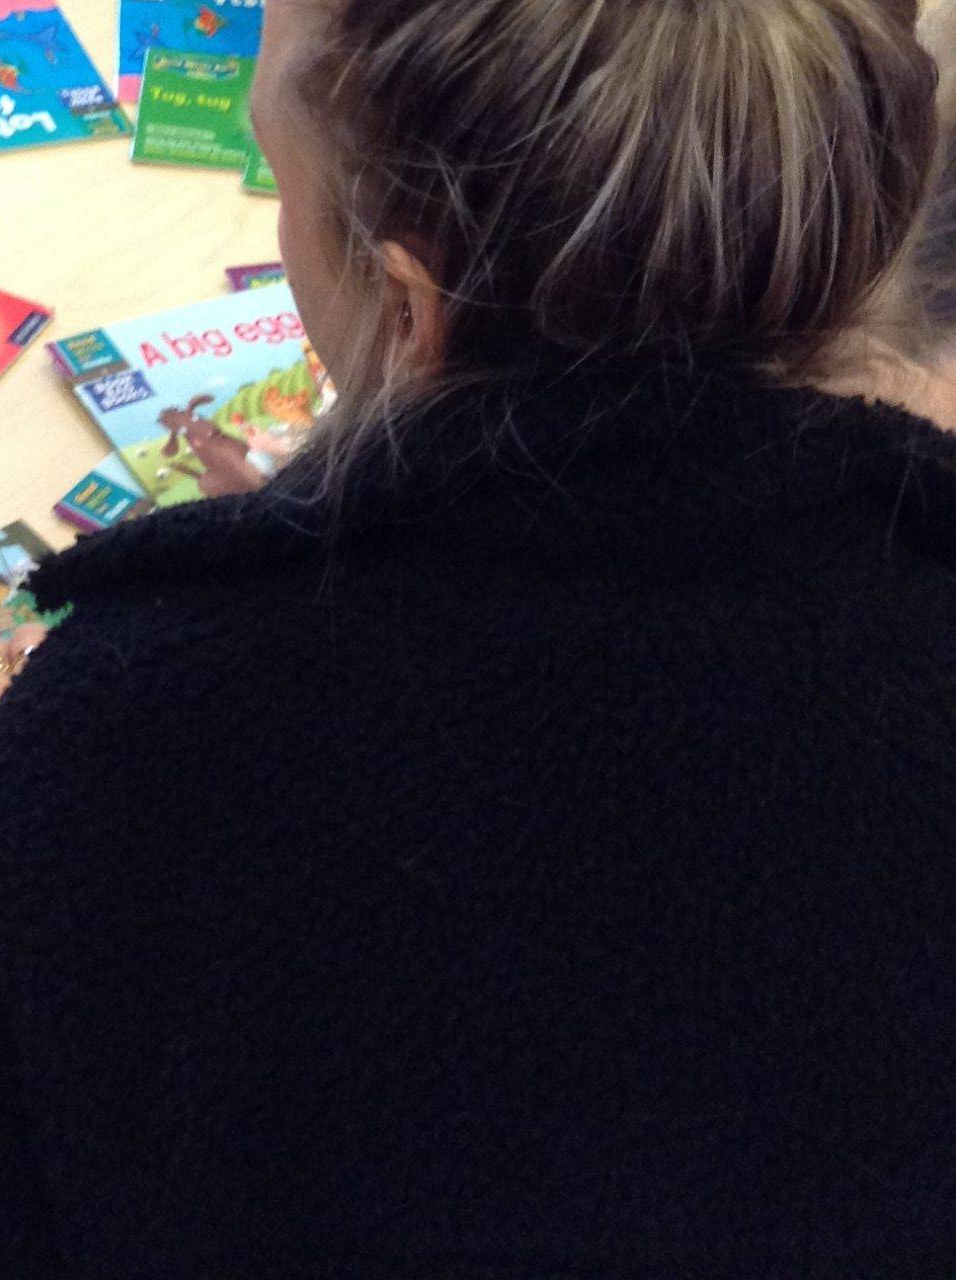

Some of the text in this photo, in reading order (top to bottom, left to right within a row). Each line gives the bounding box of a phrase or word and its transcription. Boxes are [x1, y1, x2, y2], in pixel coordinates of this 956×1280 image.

[139, 341, 168, 368] A
[160, 328, 233, 358] big
[233, 311, 306, 344] egg
